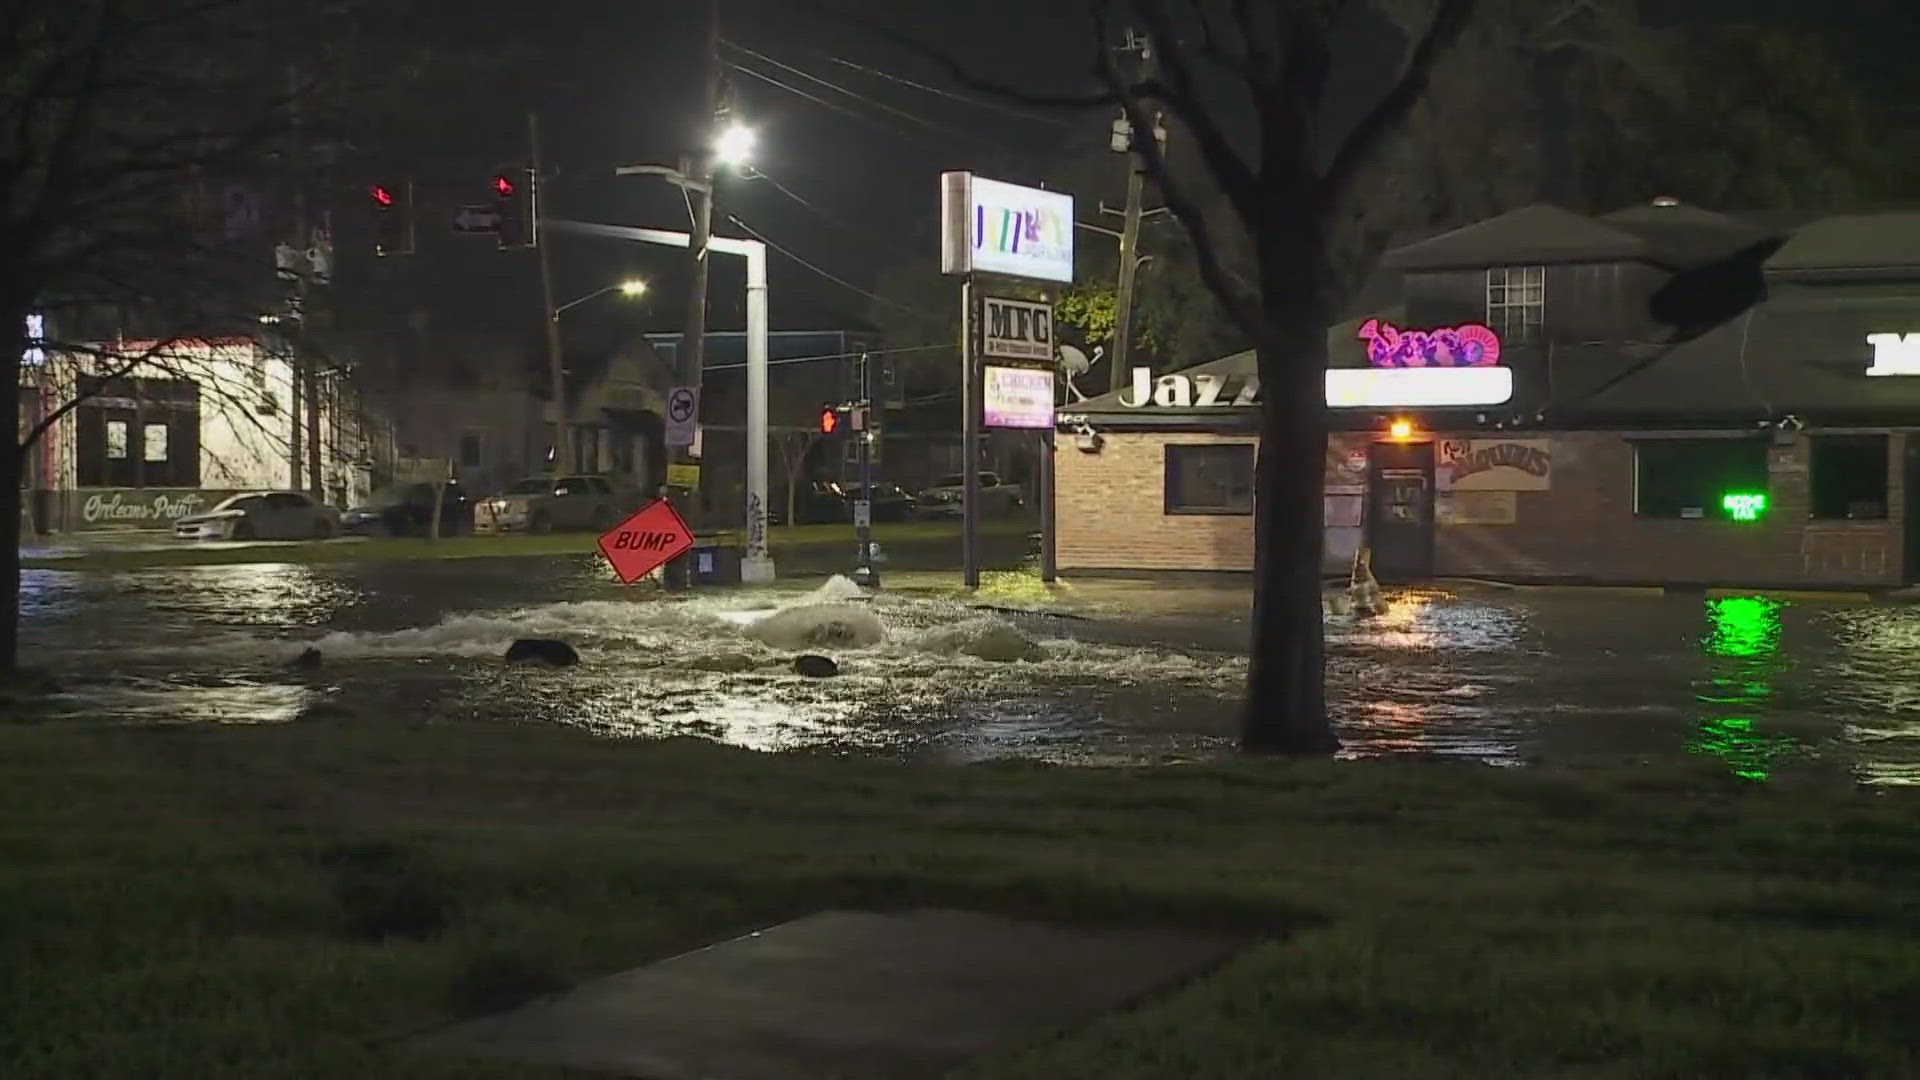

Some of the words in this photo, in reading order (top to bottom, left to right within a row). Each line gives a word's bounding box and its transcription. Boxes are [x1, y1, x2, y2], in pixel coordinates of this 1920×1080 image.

[989, 303, 1049, 343] MFG
[1119, 367, 1264, 408] Jazz
[614, 531, 676, 551] BUMP
